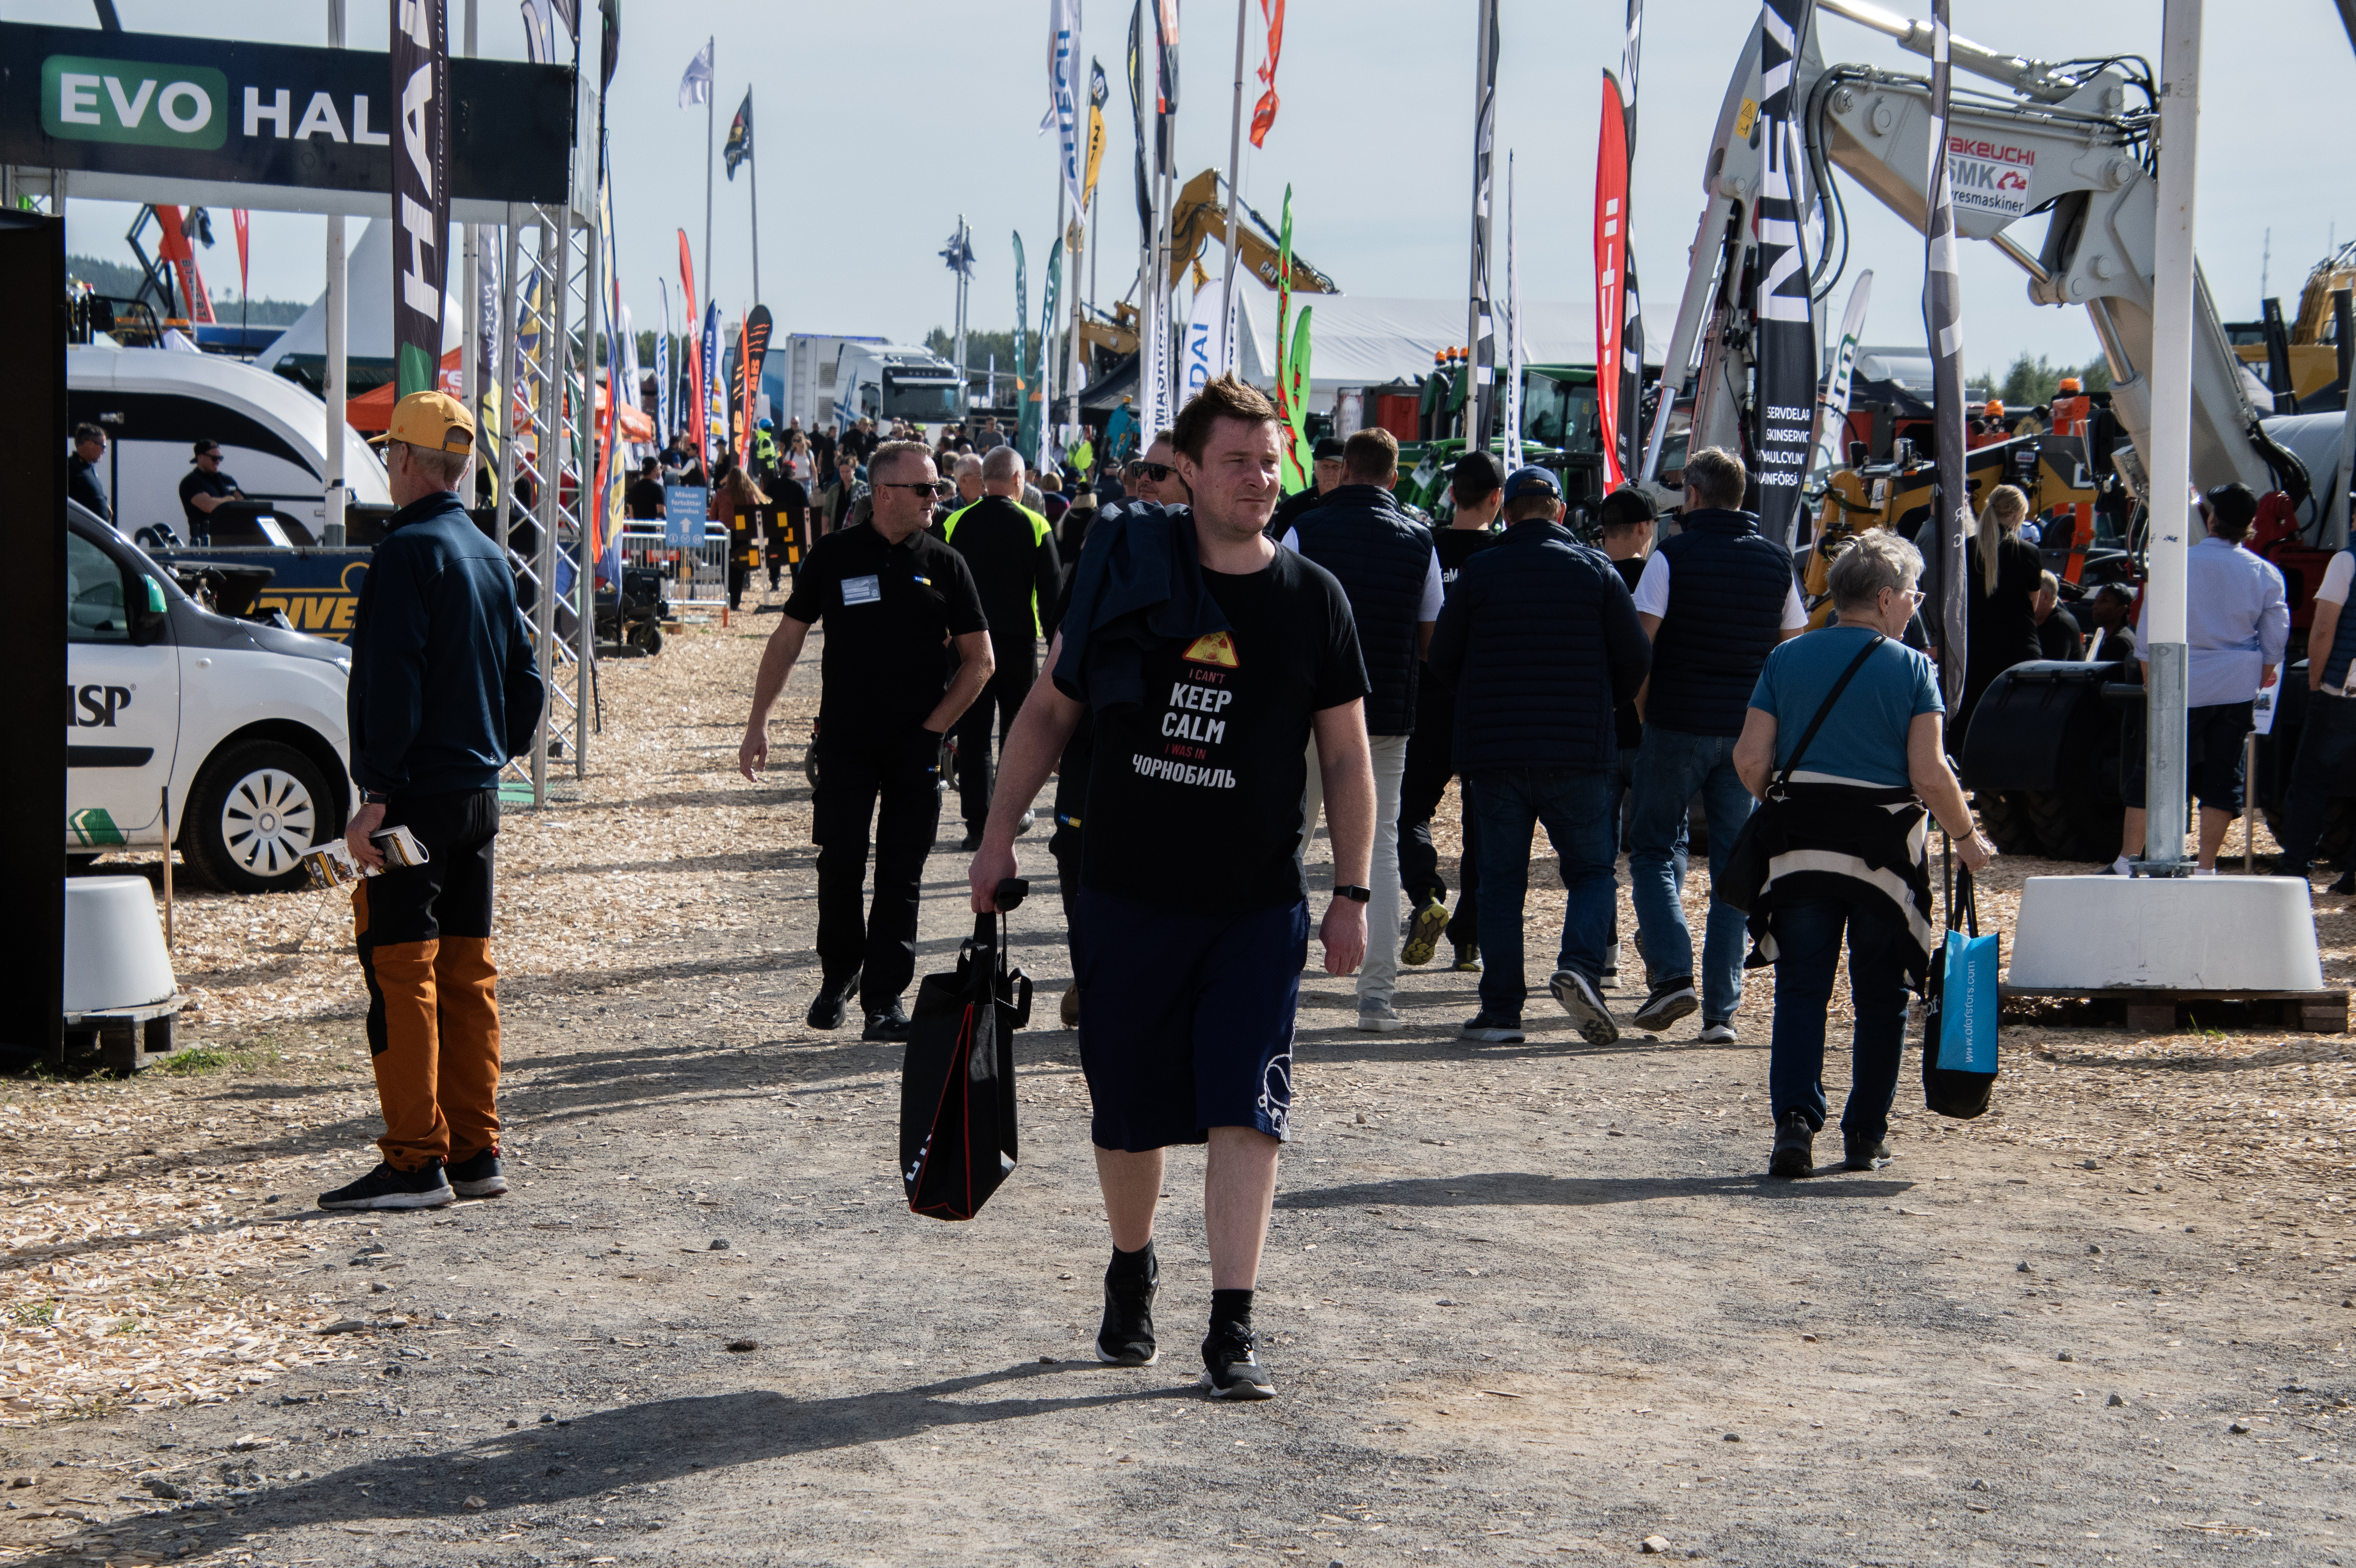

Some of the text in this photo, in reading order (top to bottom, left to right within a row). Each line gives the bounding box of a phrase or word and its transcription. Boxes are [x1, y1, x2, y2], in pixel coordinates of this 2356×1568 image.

[60, 73, 389, 146] EVO HAL
[1952, 191, 2024, 213] resmaskiner
[1259, 260, 1278, 283] CAT
[1189, 669, 1225, 684] I CAN'T
[1169, 683, 1232, 712] KEEP
[1162, 712, 1225, 744] CALM
[1165, 744, 1206, 760] I WAS IN
[1133, 754, 1236, 788] ЧОРНОБИЛЬ
